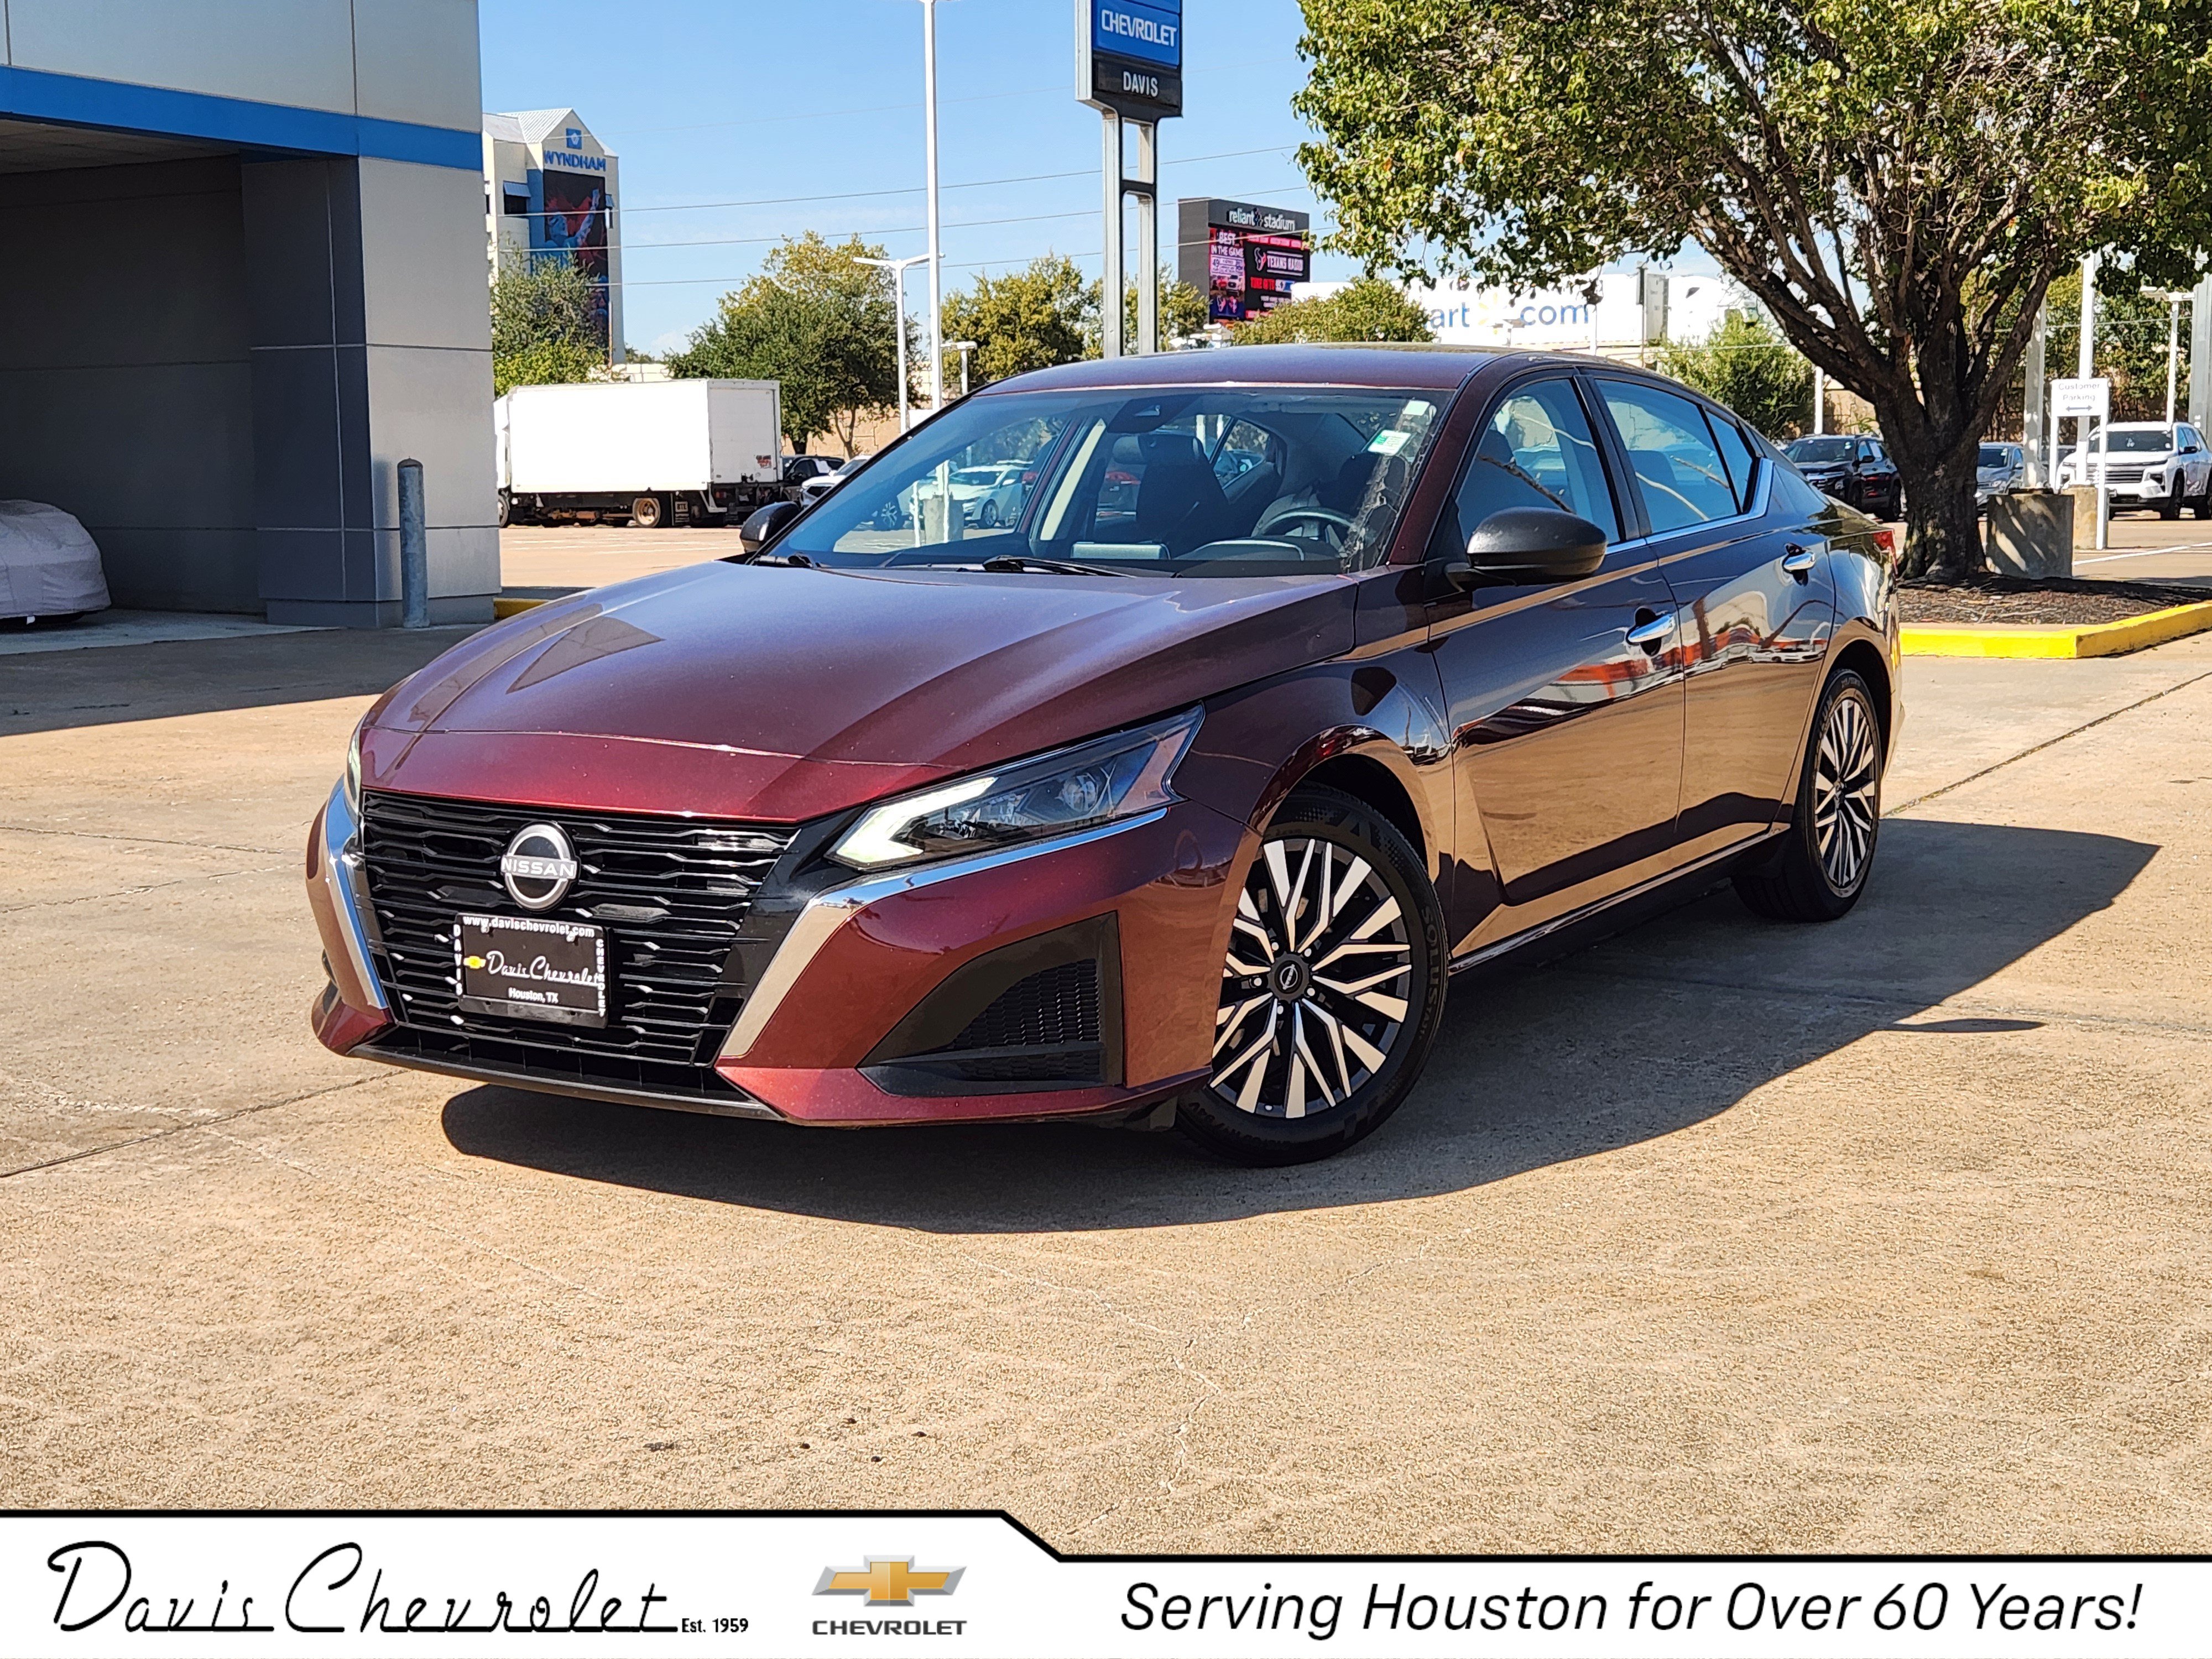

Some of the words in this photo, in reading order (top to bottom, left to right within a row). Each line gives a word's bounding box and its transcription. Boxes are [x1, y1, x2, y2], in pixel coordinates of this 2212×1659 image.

[1102, 9, 1177, 47] CHEVROLET
[1123, 71, 1159, 97] DAVIS
[544, 150, 606, 172] WYNDHAM
[1228, 208, 1255, 226] reliant
[1264, 213, 1296, 231] stadium
[501, 857, 576, 878] NISSAN
[463, 915, 595, 938] www.davischevrolet.com
[453, 924, 463, 996] DAVIS
[486, 950, 531, 979] Davis
[529, 955, 599, 987] Chevrolet
[596, 938, 607, 1018] CHEVROLET
[508, 987, 546, 1003] Houston,
[546, 992, 559, 1004] TX
